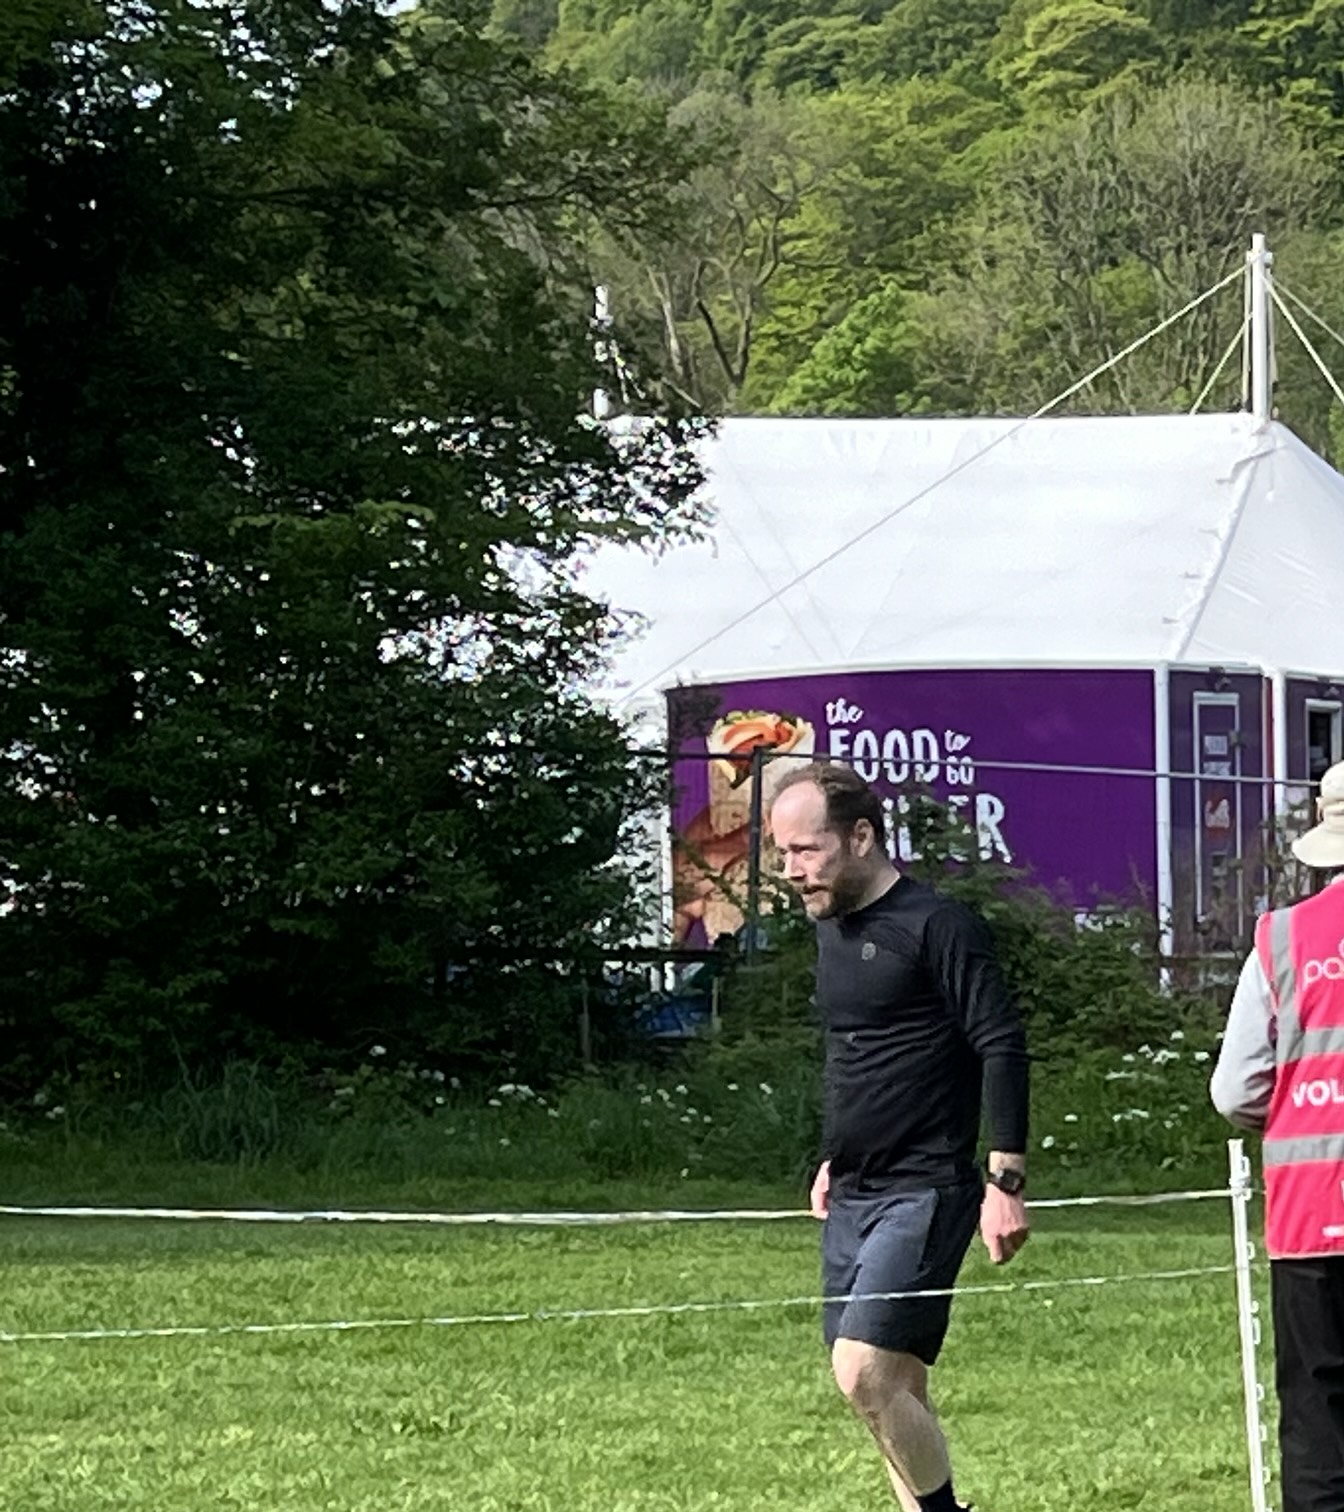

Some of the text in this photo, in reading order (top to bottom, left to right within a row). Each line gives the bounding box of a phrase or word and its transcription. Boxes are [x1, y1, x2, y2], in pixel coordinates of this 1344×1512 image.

[825, 698, 864, 725] the
[944, 729, 971, 752] to
[829, 728, 940, 784] FOOD
